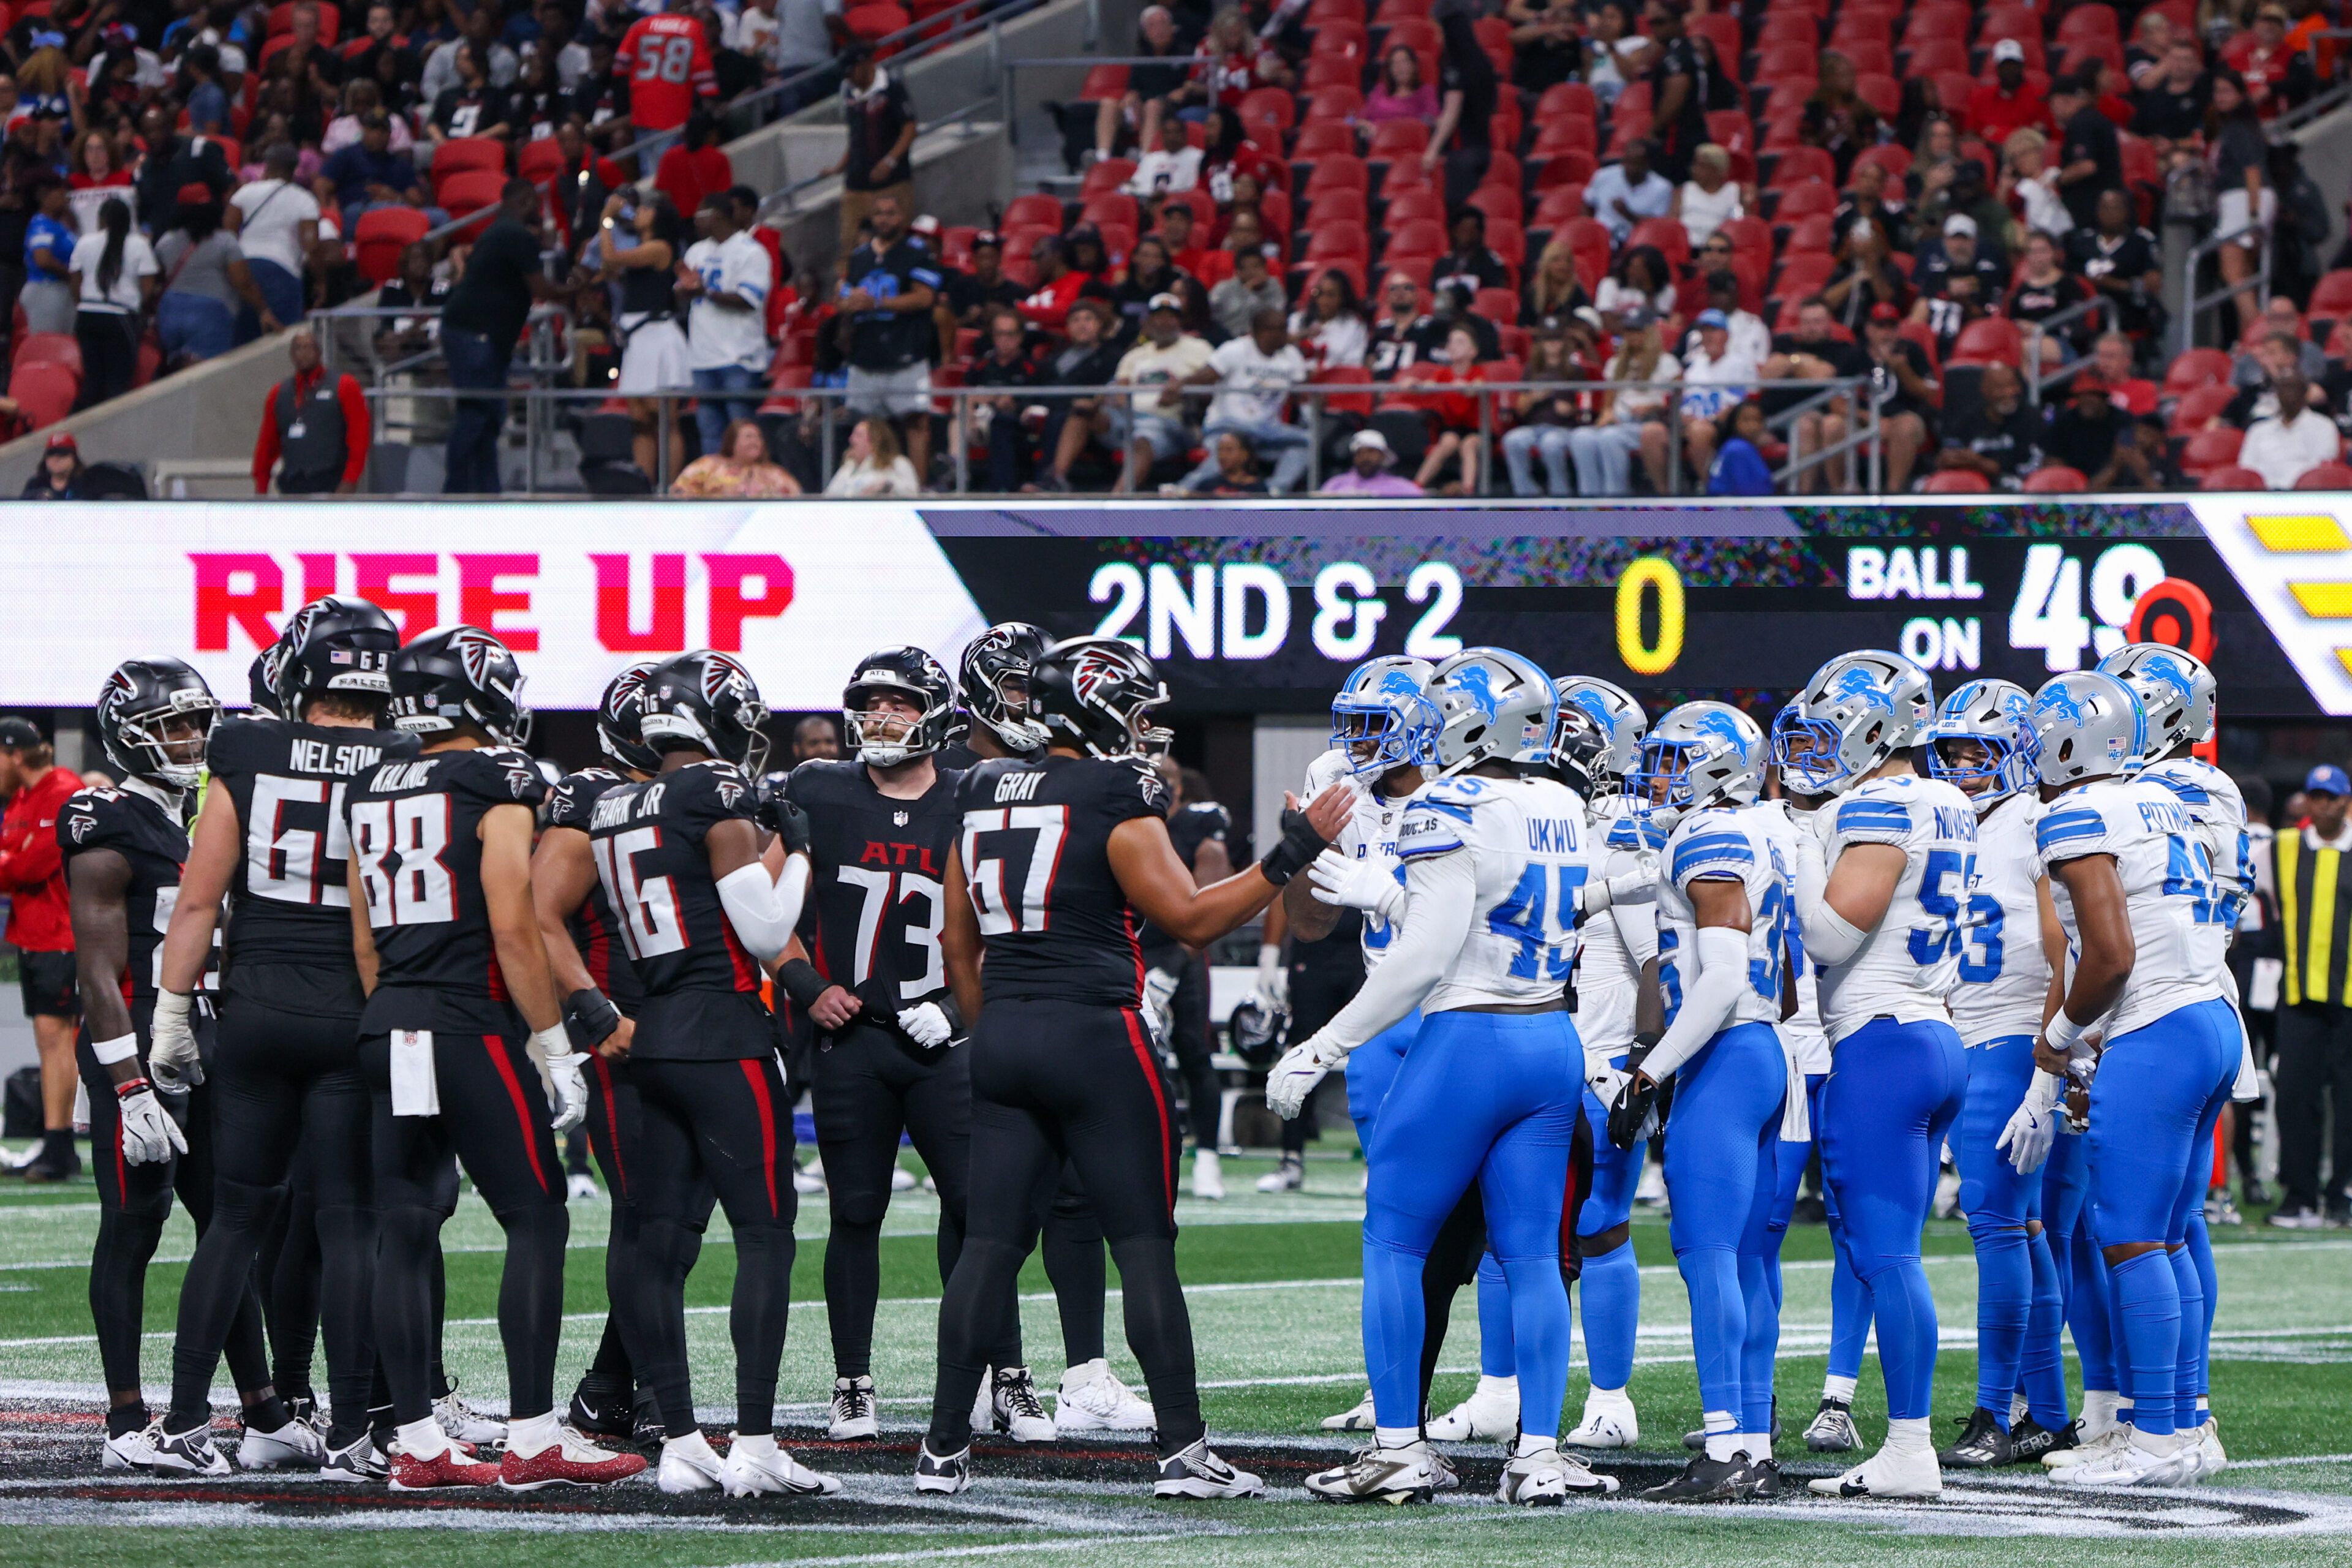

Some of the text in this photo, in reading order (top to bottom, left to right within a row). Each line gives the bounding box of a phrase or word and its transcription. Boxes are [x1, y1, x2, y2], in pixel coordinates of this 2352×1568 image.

[635, 35, 693, 84] 58
[1847, 545, 1984, 600] BALL
[186, 552, 796, 652] RISE UP
[1088, 561, 1464, 660] 2ND & 2
[1615, 557, 1686, 675] 0
[2009, 543, 2168, 673] 49
[360, 650, 388, 671] 69
[1899, 617, 1981, 671] ON
[339, 679, 390, 688] FALCO
[394, 696, 418, 716] 88
[644, 693, 658, 714] 16
[289, 738, 382, 776] NELSON
[636, 782, 666, 819] JR
[994, 771, 1046, 803] GRAY
[1527, 818, 1577, 853] UKWU
[2136, 802, 2194, 834] PITTMA
[350, 793, 459, 928] 88
[860, 841, 940, 875] ATL
[961, 804, 1069, 936] 67
[590, 825, 692, 961] 16
[836, 864, 947, 1001] 73
[1488, 863, 1589, 981] 45
[404, 1035, 417, 1044] NFL
[1185, 1465, 1211, 1480] FORCE
[1358, 1467, 1382, 1485] ALPHA
